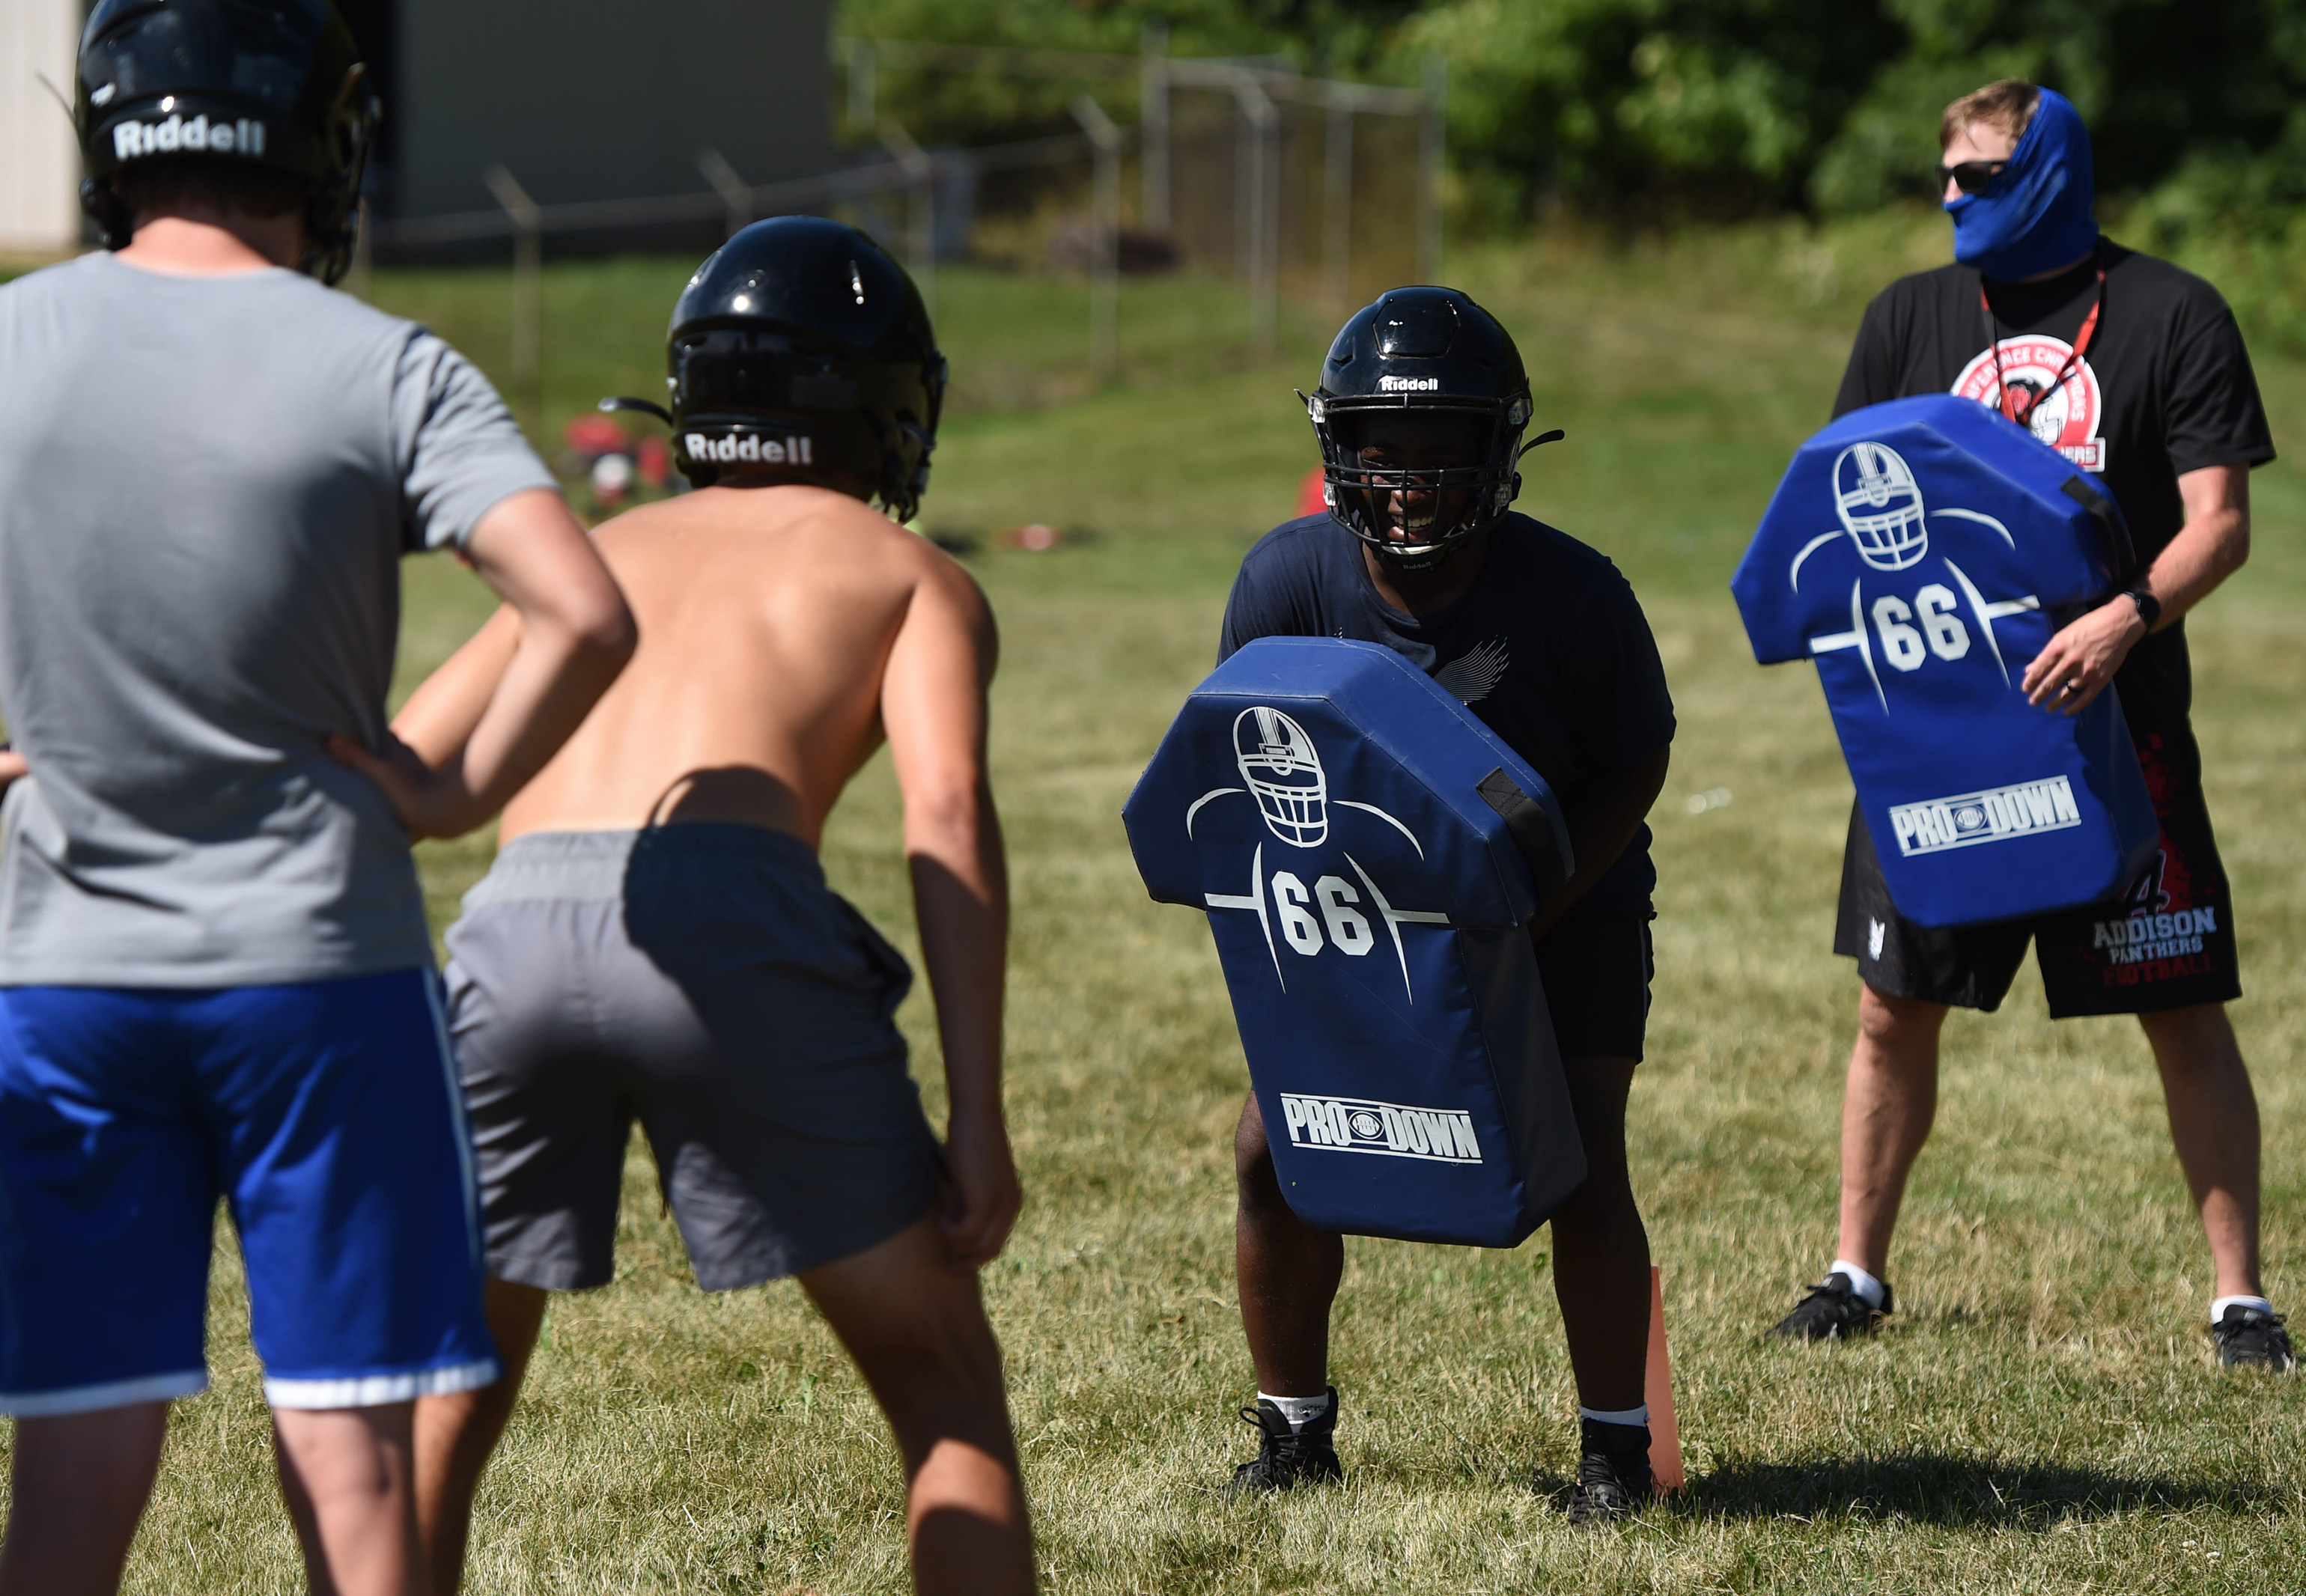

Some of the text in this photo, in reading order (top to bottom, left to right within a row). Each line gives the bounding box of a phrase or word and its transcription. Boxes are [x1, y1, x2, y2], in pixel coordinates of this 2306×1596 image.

[113, 113, 266, 161] Riddell
[1381, 377, 1439, 391] Riddell
[684, 433, 813, 465] Riddell
[1873, 583, 1971, 672] 66
[1891, 779, 2081, 850] PRO DOWN
[1271, 871, 1375, 957] 66
[2093, 905, 2218, 949] ADDISON
[2102, 951, 2219, 987] FOOTBALL
[2109, 935, 2203, 966] PANTHERS
[1280, 1097, 1482, 1158] PRO DOWN
